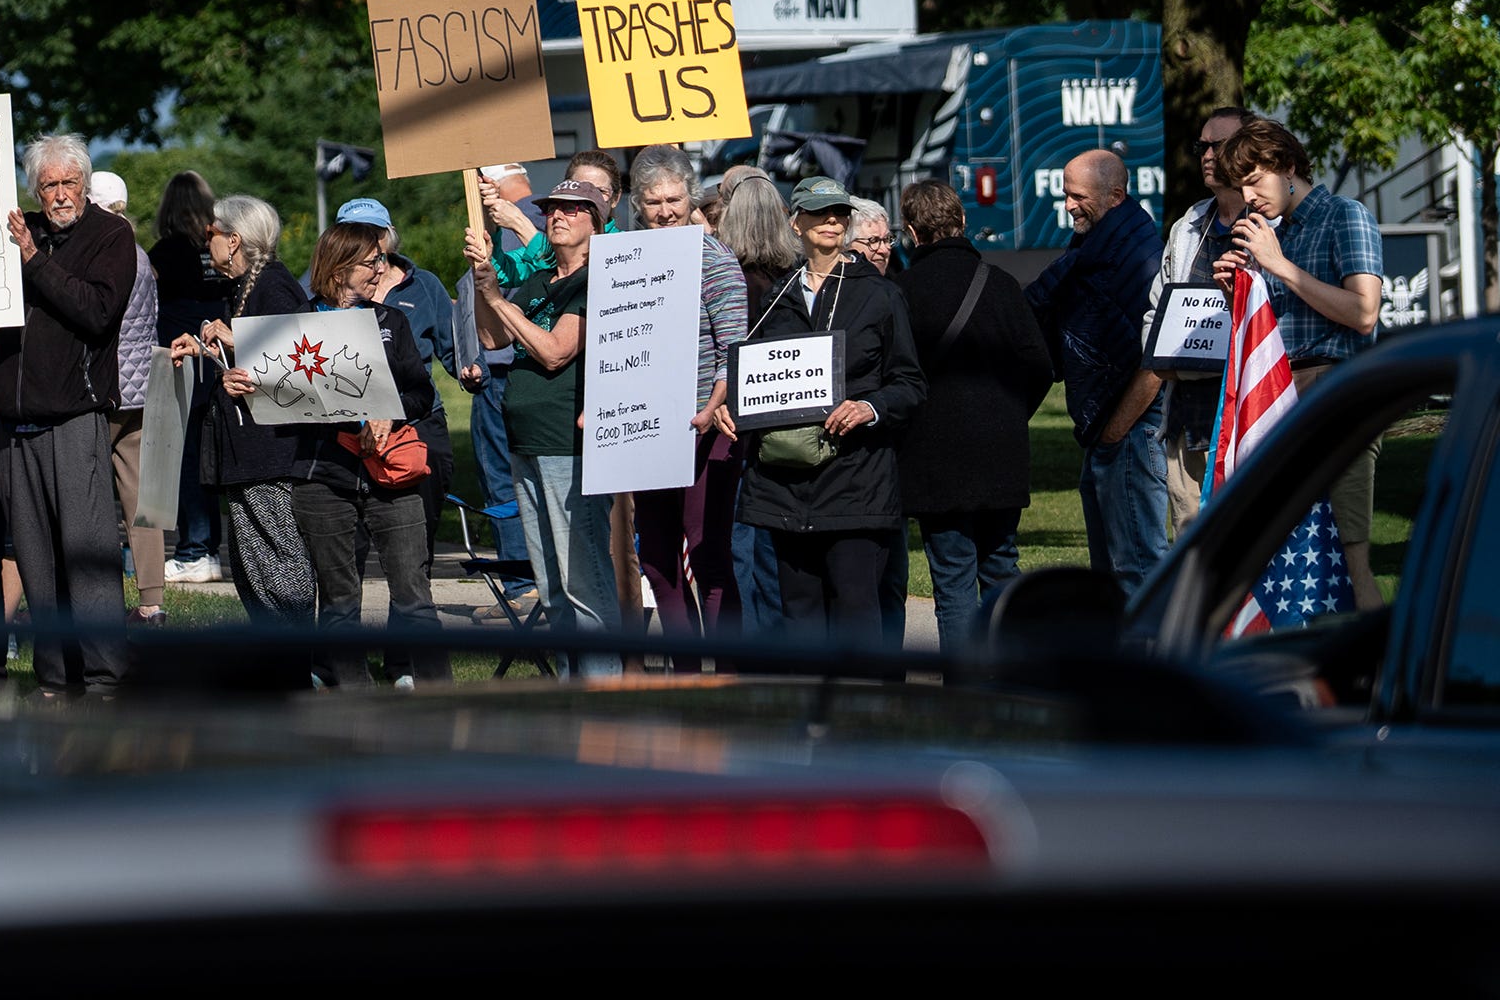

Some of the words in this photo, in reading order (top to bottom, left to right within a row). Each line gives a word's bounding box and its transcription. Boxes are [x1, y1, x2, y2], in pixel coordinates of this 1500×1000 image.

[371, 5, 543, 91] FASCISM
[625, 66, 718, 123] U.S.
[1061, 87, 1138, 126] NAVY
[604, 247, 642, 268] gestapo??
[1182, 297, 1199, 307] No
[1184, 316, 1197, 328] in
[1200, 318, 1222, 329] the
[598, 331, 607, 345] IN
[609, 328, 623, 341] THE
[1183, 338, 1213, 351] USA!
[768, 348, 801, 362] Stop
[745, 369, 801, 386] Attacks
[805, 367, 824, 379] on
[743, 387, 827, 407] Immigrants
[597, 406, 616, 421] time
[617, 403, 630, 418] for
[630, 402, 647, 414] some
[596, 425, 620, 441] GOOD
[622, 418, 660, 437] TROUBLE
